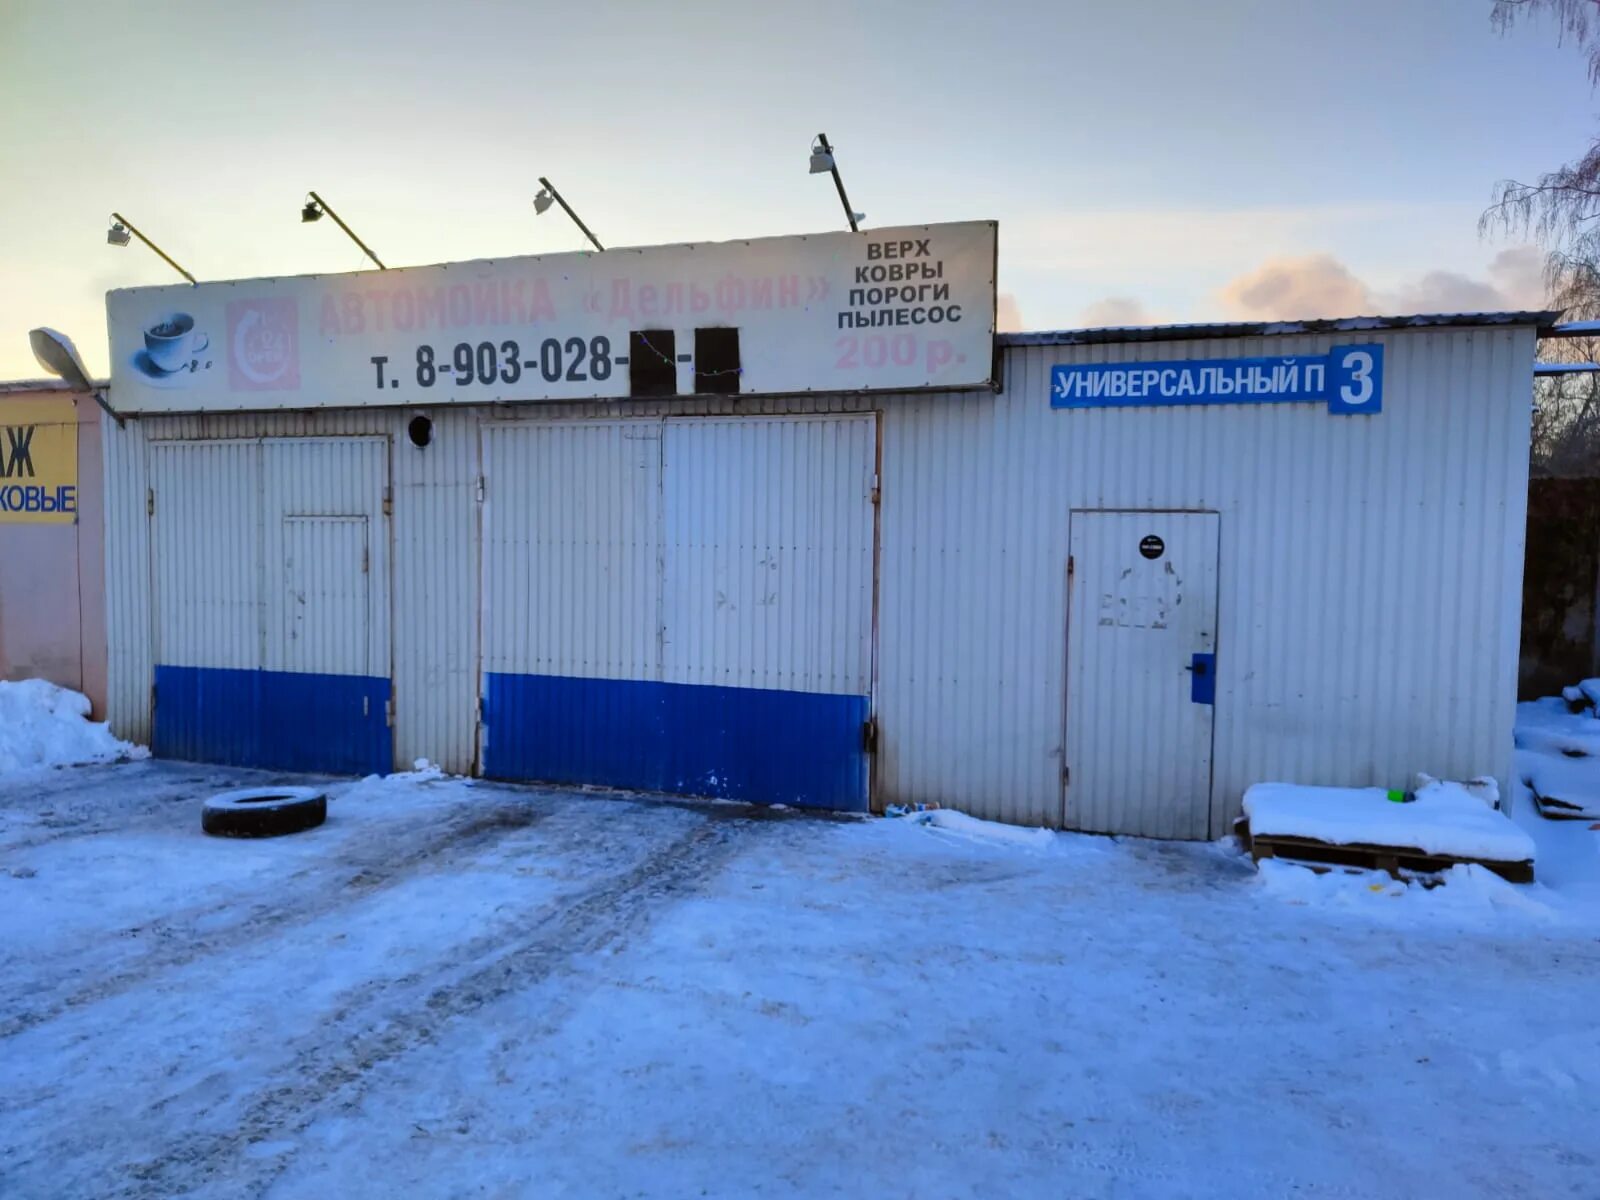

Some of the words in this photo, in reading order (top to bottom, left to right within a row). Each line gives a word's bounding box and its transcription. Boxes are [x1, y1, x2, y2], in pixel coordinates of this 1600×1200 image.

[867, 239, 931, 260] ВЕРХ
[854, 261, 943, 283] КОВРЫ
[318, 273, 555, 336] АВТОМОЙКА
[849, 283, 950, 306] ПОРОГИ
[837, 304, 963, 329] ПЫЛЕСОС
[416, 330, 738, 388] 8-903-028--
[834, 335, 918, 370] 200
[1057, 358, 1299, 399] УНИВЕРСАЛЬНЫЙ
[1304, 364, 1326, 392] П
[1340, 351, 1374, 404] 3
[0, 425, 35, 478] Ж
